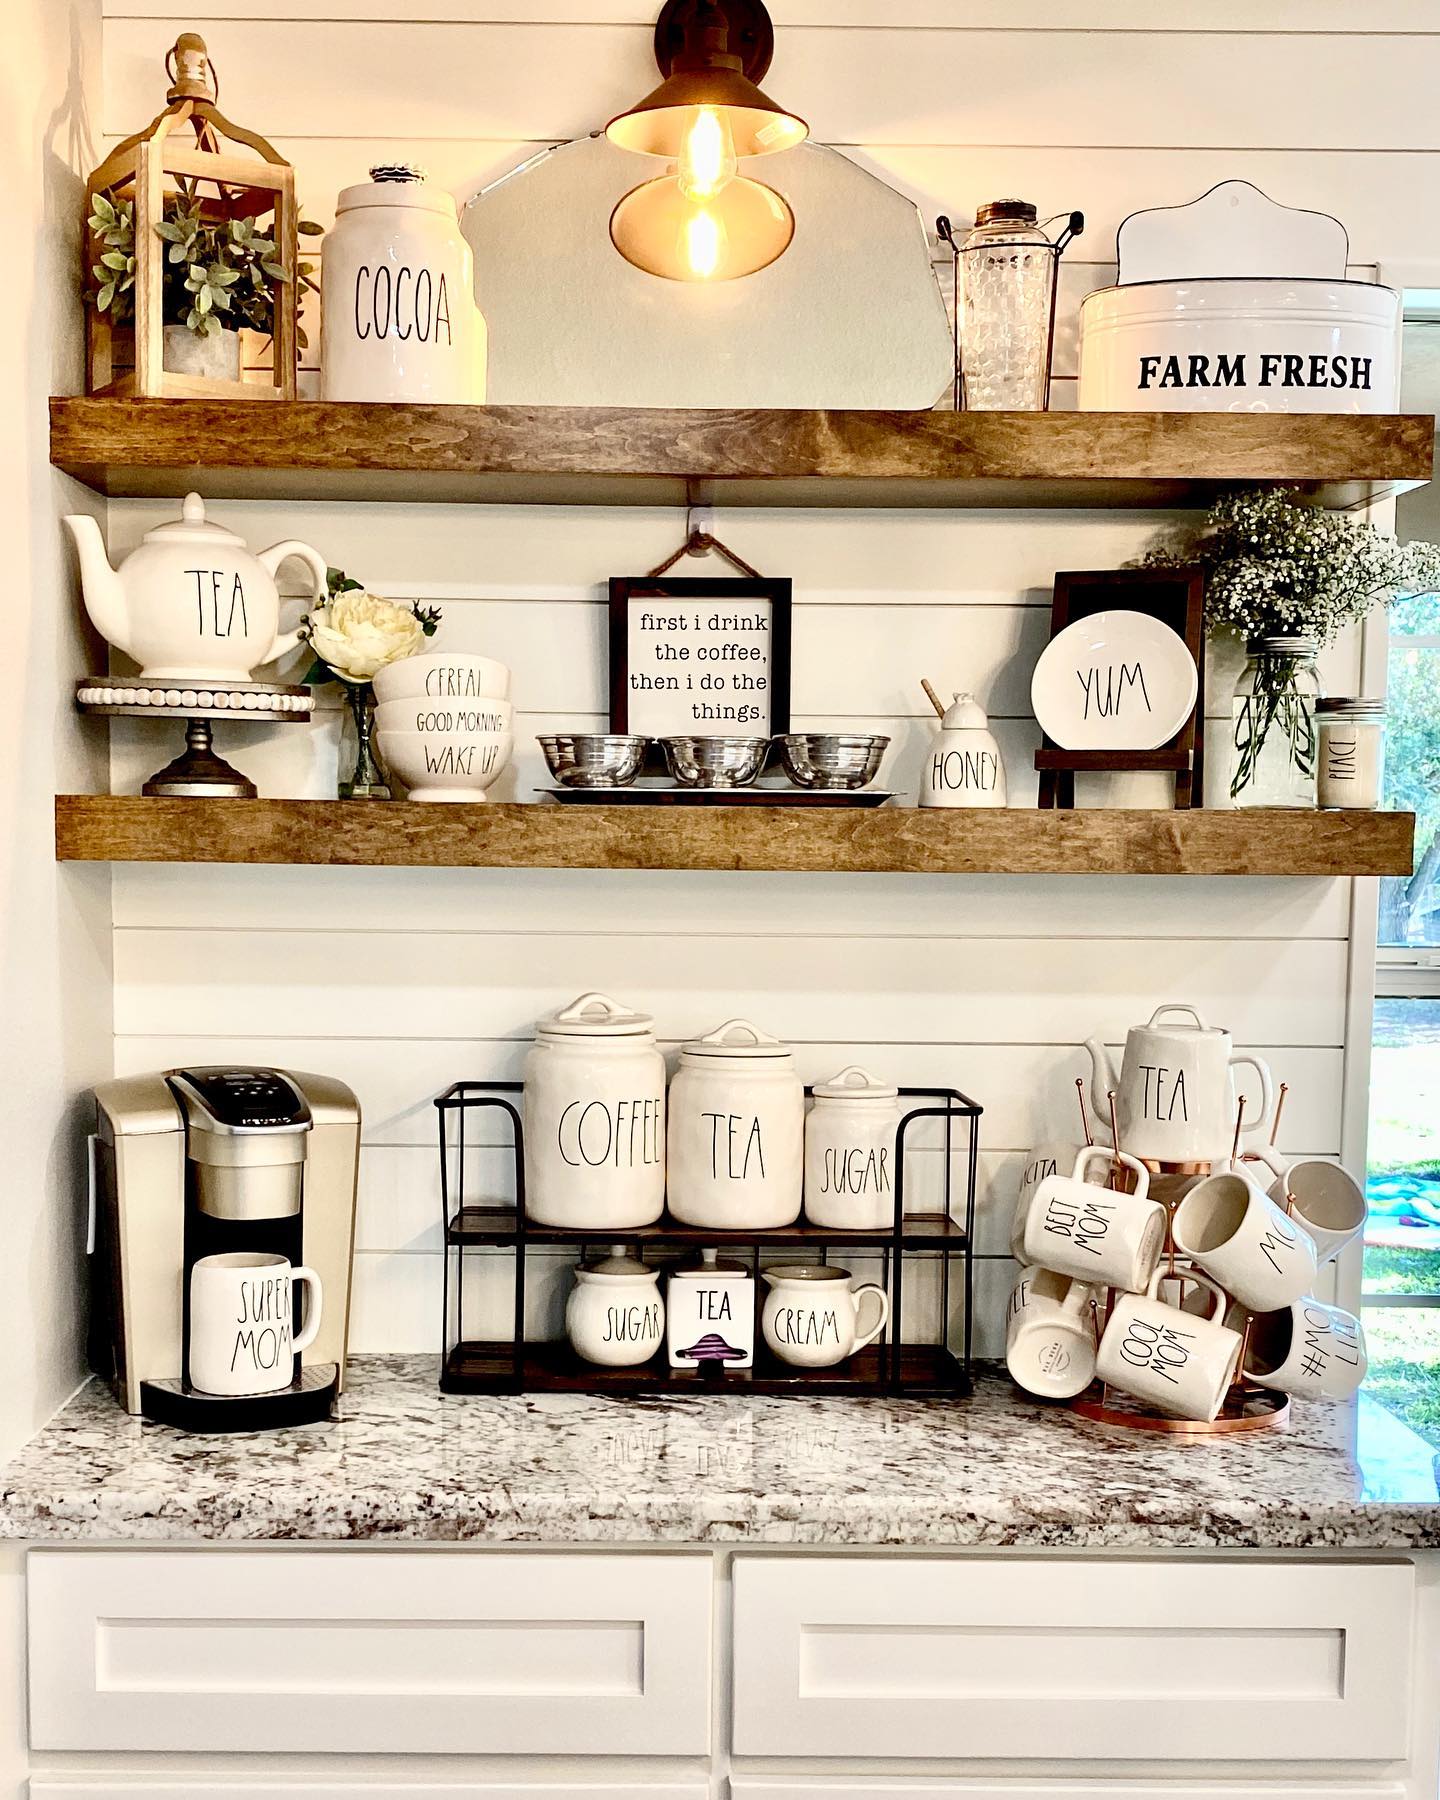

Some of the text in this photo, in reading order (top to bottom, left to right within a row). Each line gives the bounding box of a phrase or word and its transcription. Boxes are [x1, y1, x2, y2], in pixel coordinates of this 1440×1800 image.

[355, 265, 452, 346] COCOA
[1137, 354, 1373, 390] FARM FRESH
[183, 570, 248, 638] TEA
[640, 613, 769, 631] first i drink
[655, 643, 768, 664] the coffee,
[630, 673, 767, 690] then i do the
[1076, 662, 1152, 720] YUM
[416, 711, 503, 732] GOOD MORNING
[692, 703, 766, 723] things.
[423, 744, 499, 775] WAKE UP
[932, 751, 998, 791] HONEY
[1328, 740, 1356, 780] PEACE
[1138, 1065, 1188, 1122] TEA
[558, 1098, 661, 1167] COFFEE
[701, 1113, 765, 1179] TEA
[820, 1147, 891, 1194] SUGAR
[1044, 1197, 1080, 1237] BEST
[1073, 1203, 1117, 1256] MOM
[237, 1276, 291, 1324] SUPER
[696, 1290, 732, 1321] TEA
[602, 1303, 661, 1342] SUGAR
[774, 1307, 840, 1345] CREAM
[1119, 1318, 1164, 1367] COOL
[230, 1323, 293, 1373] MOM
[1150, 1329, 1197, 1385] MOM
